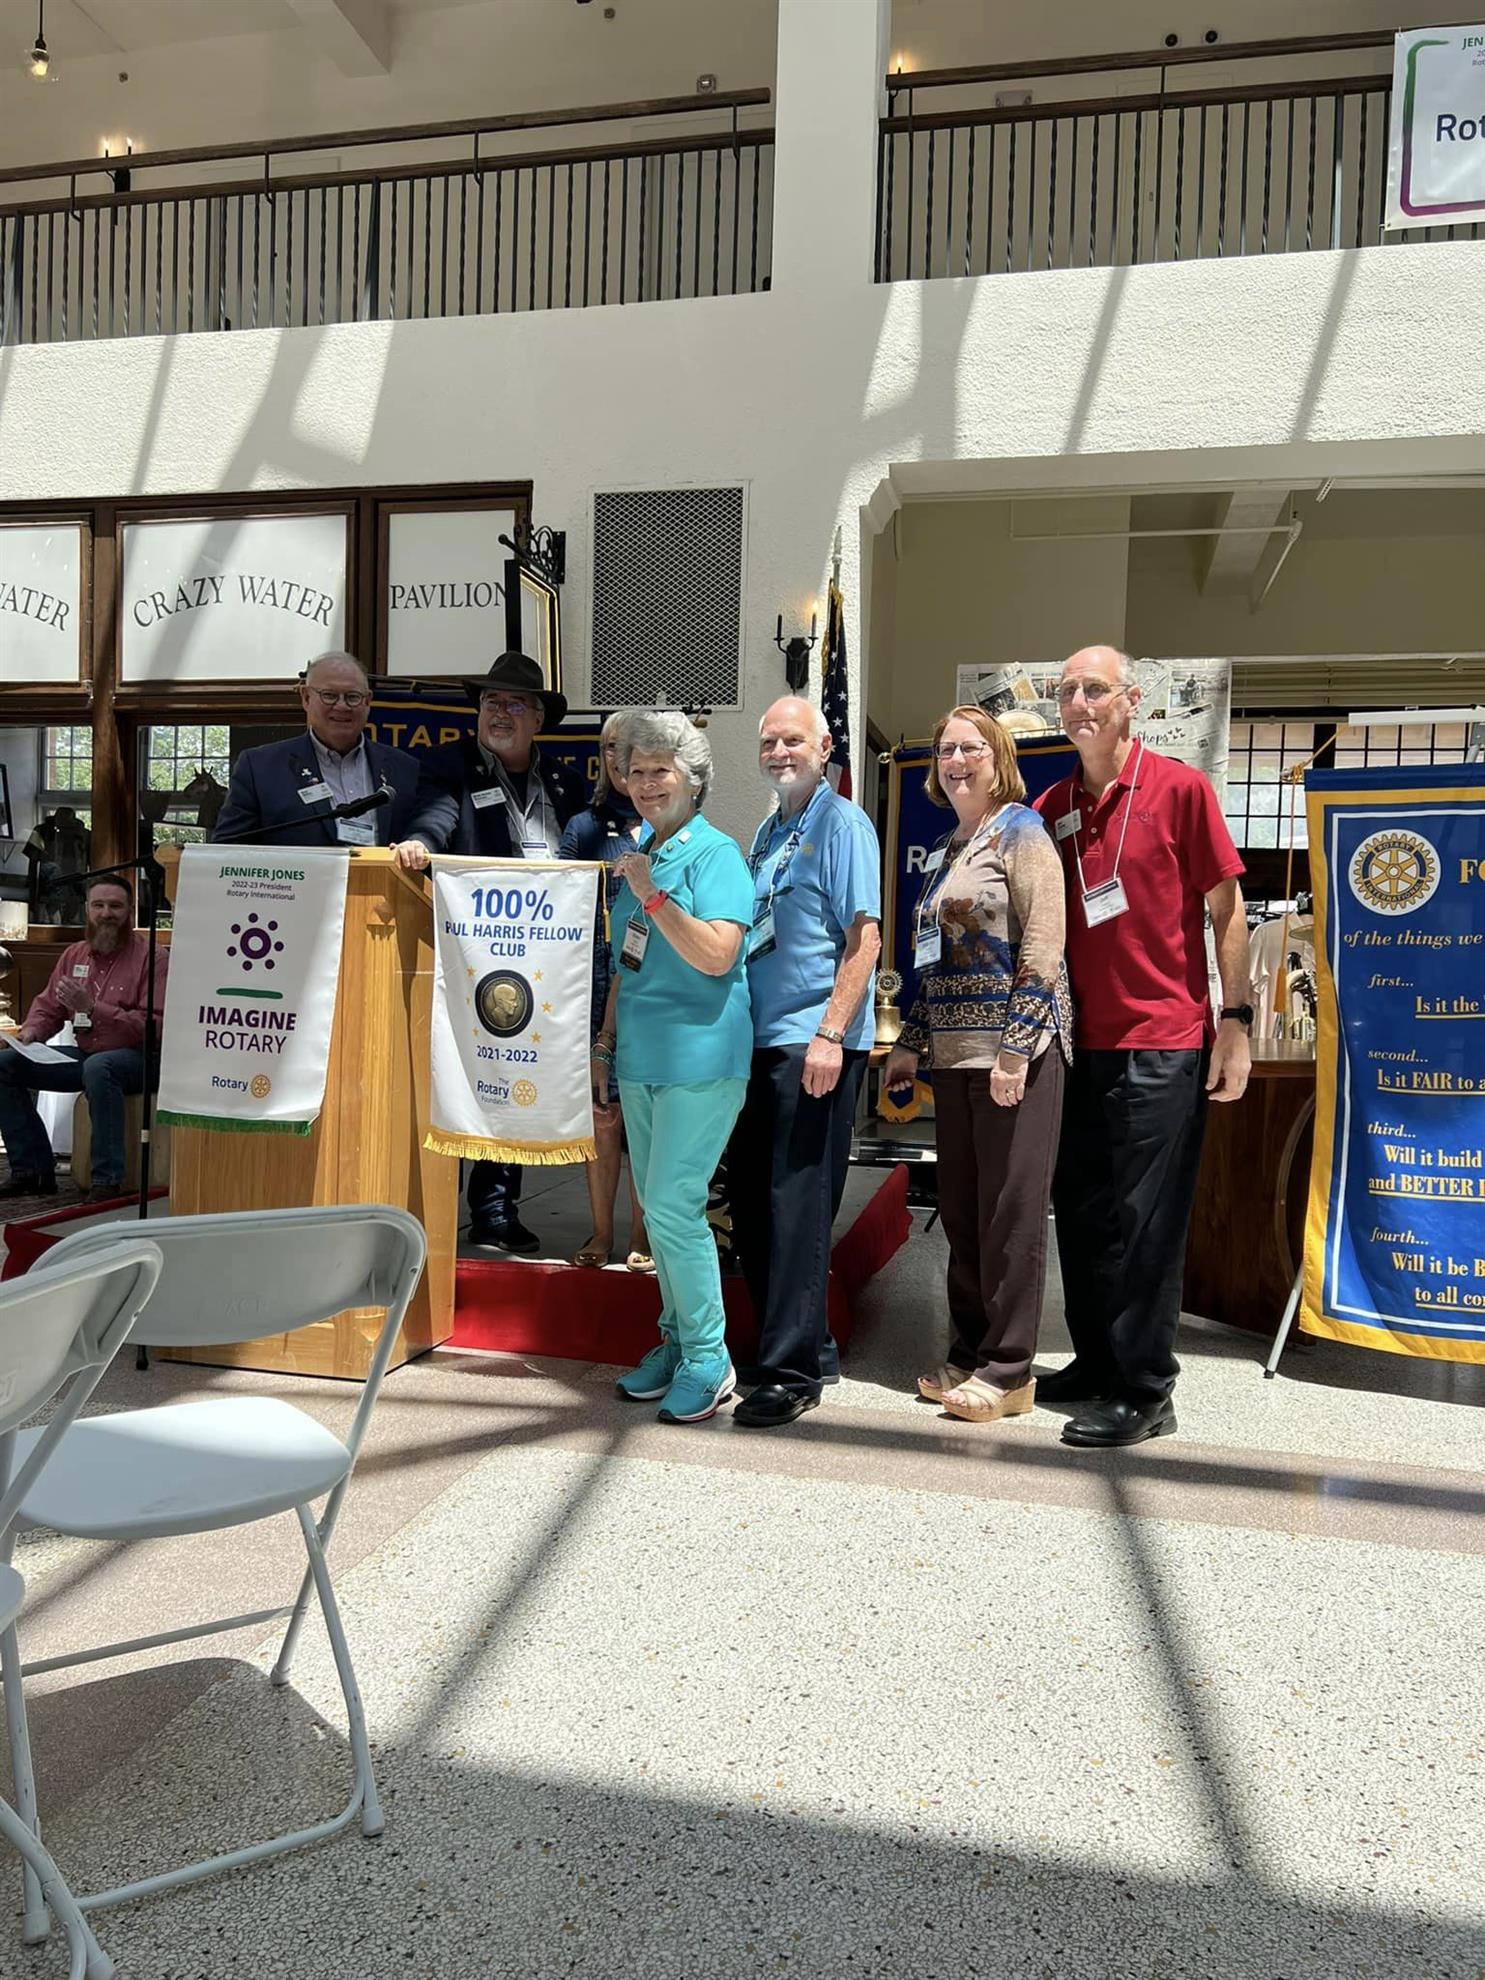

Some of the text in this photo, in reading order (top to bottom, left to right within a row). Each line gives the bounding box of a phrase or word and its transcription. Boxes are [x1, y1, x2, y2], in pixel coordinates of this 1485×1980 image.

[133, 574, 334, 628] CRAZY WATER
[390, 582, 506, 609] PAVILION
[219, 866, 305, 881] JENNIFER JONES
[226, 889, 296, 901] Rotary International
[231, 881, 292, 891] 2022-23 President
[471, 888, 554, 921] 100%
[473, 924, 525, 940] HARRIS
[529, 926, 583, 941] FELLOW
[1343, 929, 1483, 950] of the things we
[490, 942, 526, 957] CLUB
[1416, 995, 1480, 1013] Is it the
[198, 1005, 297, 1031] IMAGINE
[205, 1030, 287, 1054] ROTARY
[476, 1044, 538, 1063] 2021-2022
[211, 1075, 249, 1092] Rotary
[1378, 1068, 1391, 1086] Is
[1395, 1071, 1407, 1088] it
[1412, 1071, 1452, 1090] FAIR
[1457, 1077, 1474, 1090] to
[477, 1080, 509, 1099] Rotary
[1384, 1144, 1483, 1168] Will it build
[1368, 1172, 1396, 1190] and
[1400, 1173, 1475, 1197] BETTER
[1391, 1251, 1425, 1273] Will
[1428, 1255, 1443, 1274] it
[1447, 1256, 1470, 1276] be
[1415, 1286, 1432, 1302] to
[1436, 1285, 1459, 1305] all
